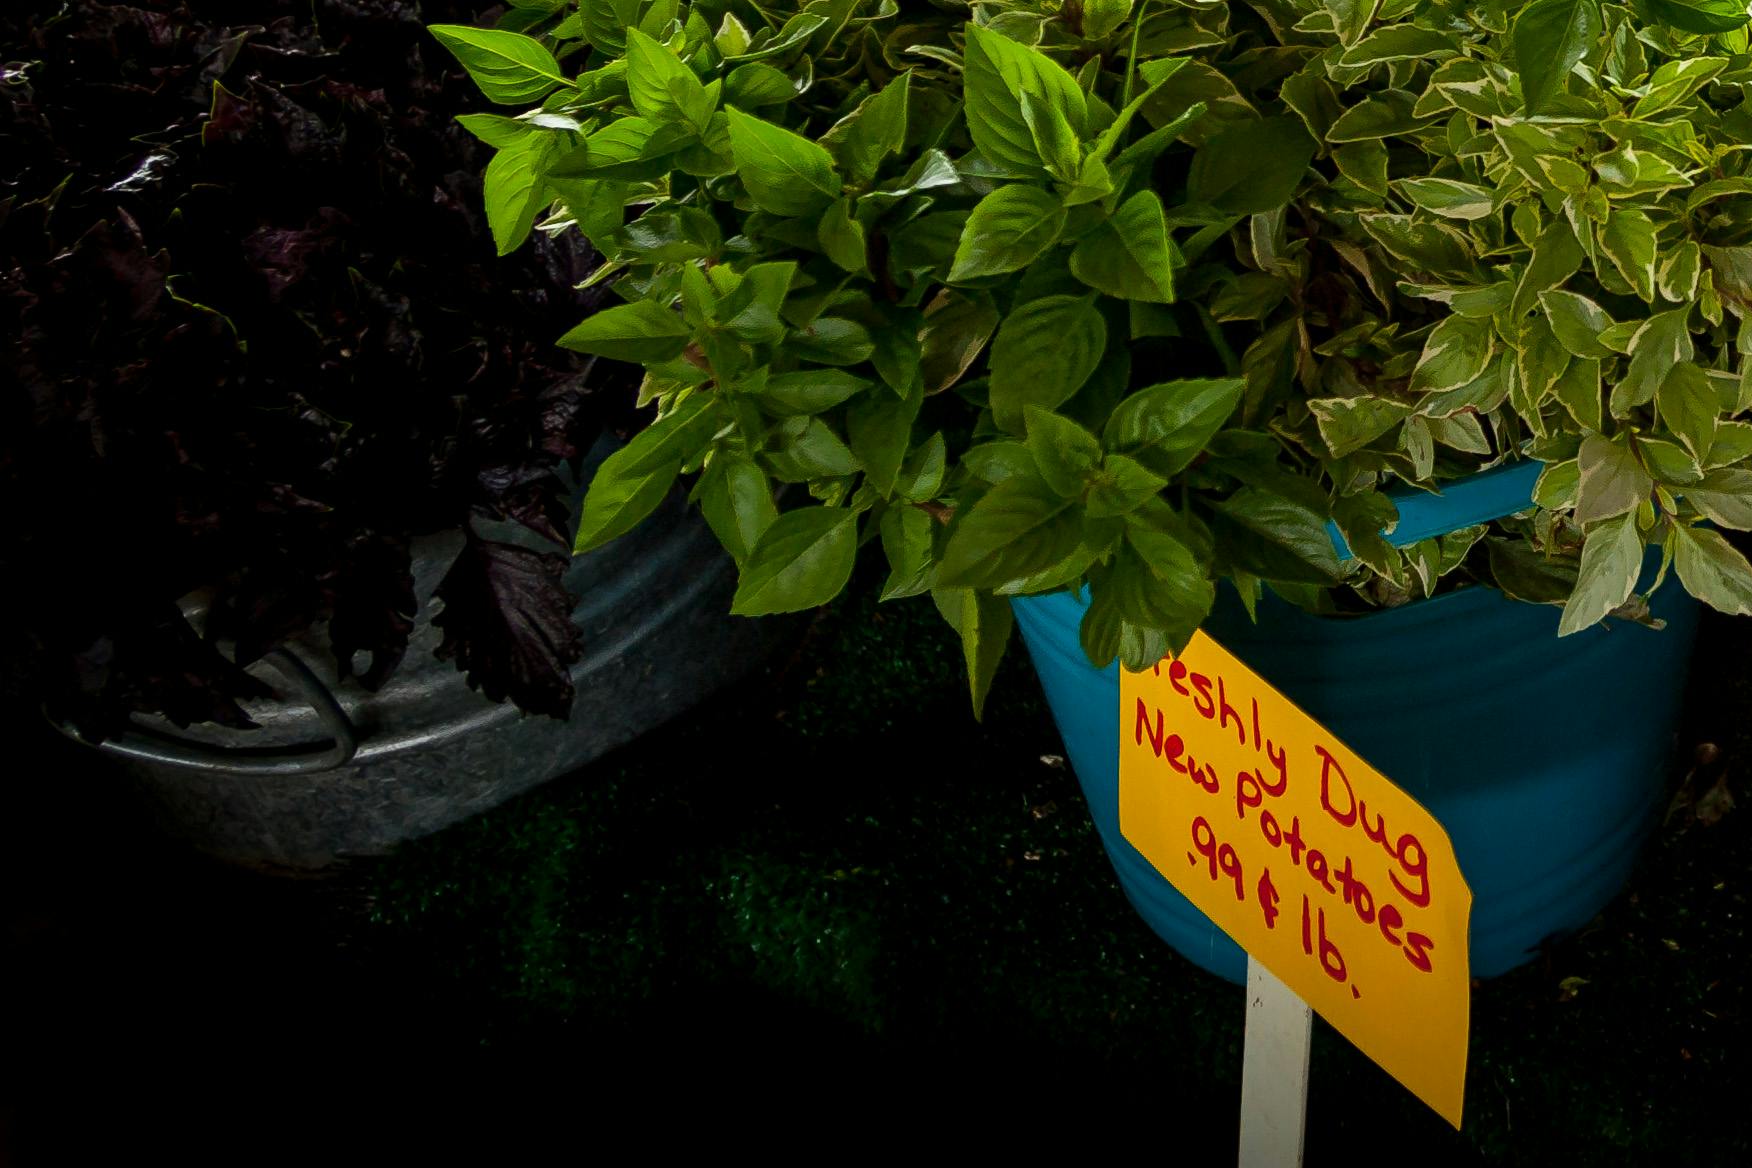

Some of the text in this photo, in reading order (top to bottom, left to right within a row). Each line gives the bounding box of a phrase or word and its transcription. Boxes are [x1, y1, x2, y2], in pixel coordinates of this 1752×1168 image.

[1135, 697, 1220, 795] New
[1314, 744, 1431, 908] Dug
[1302, 893, 1362, 1000] lb.
